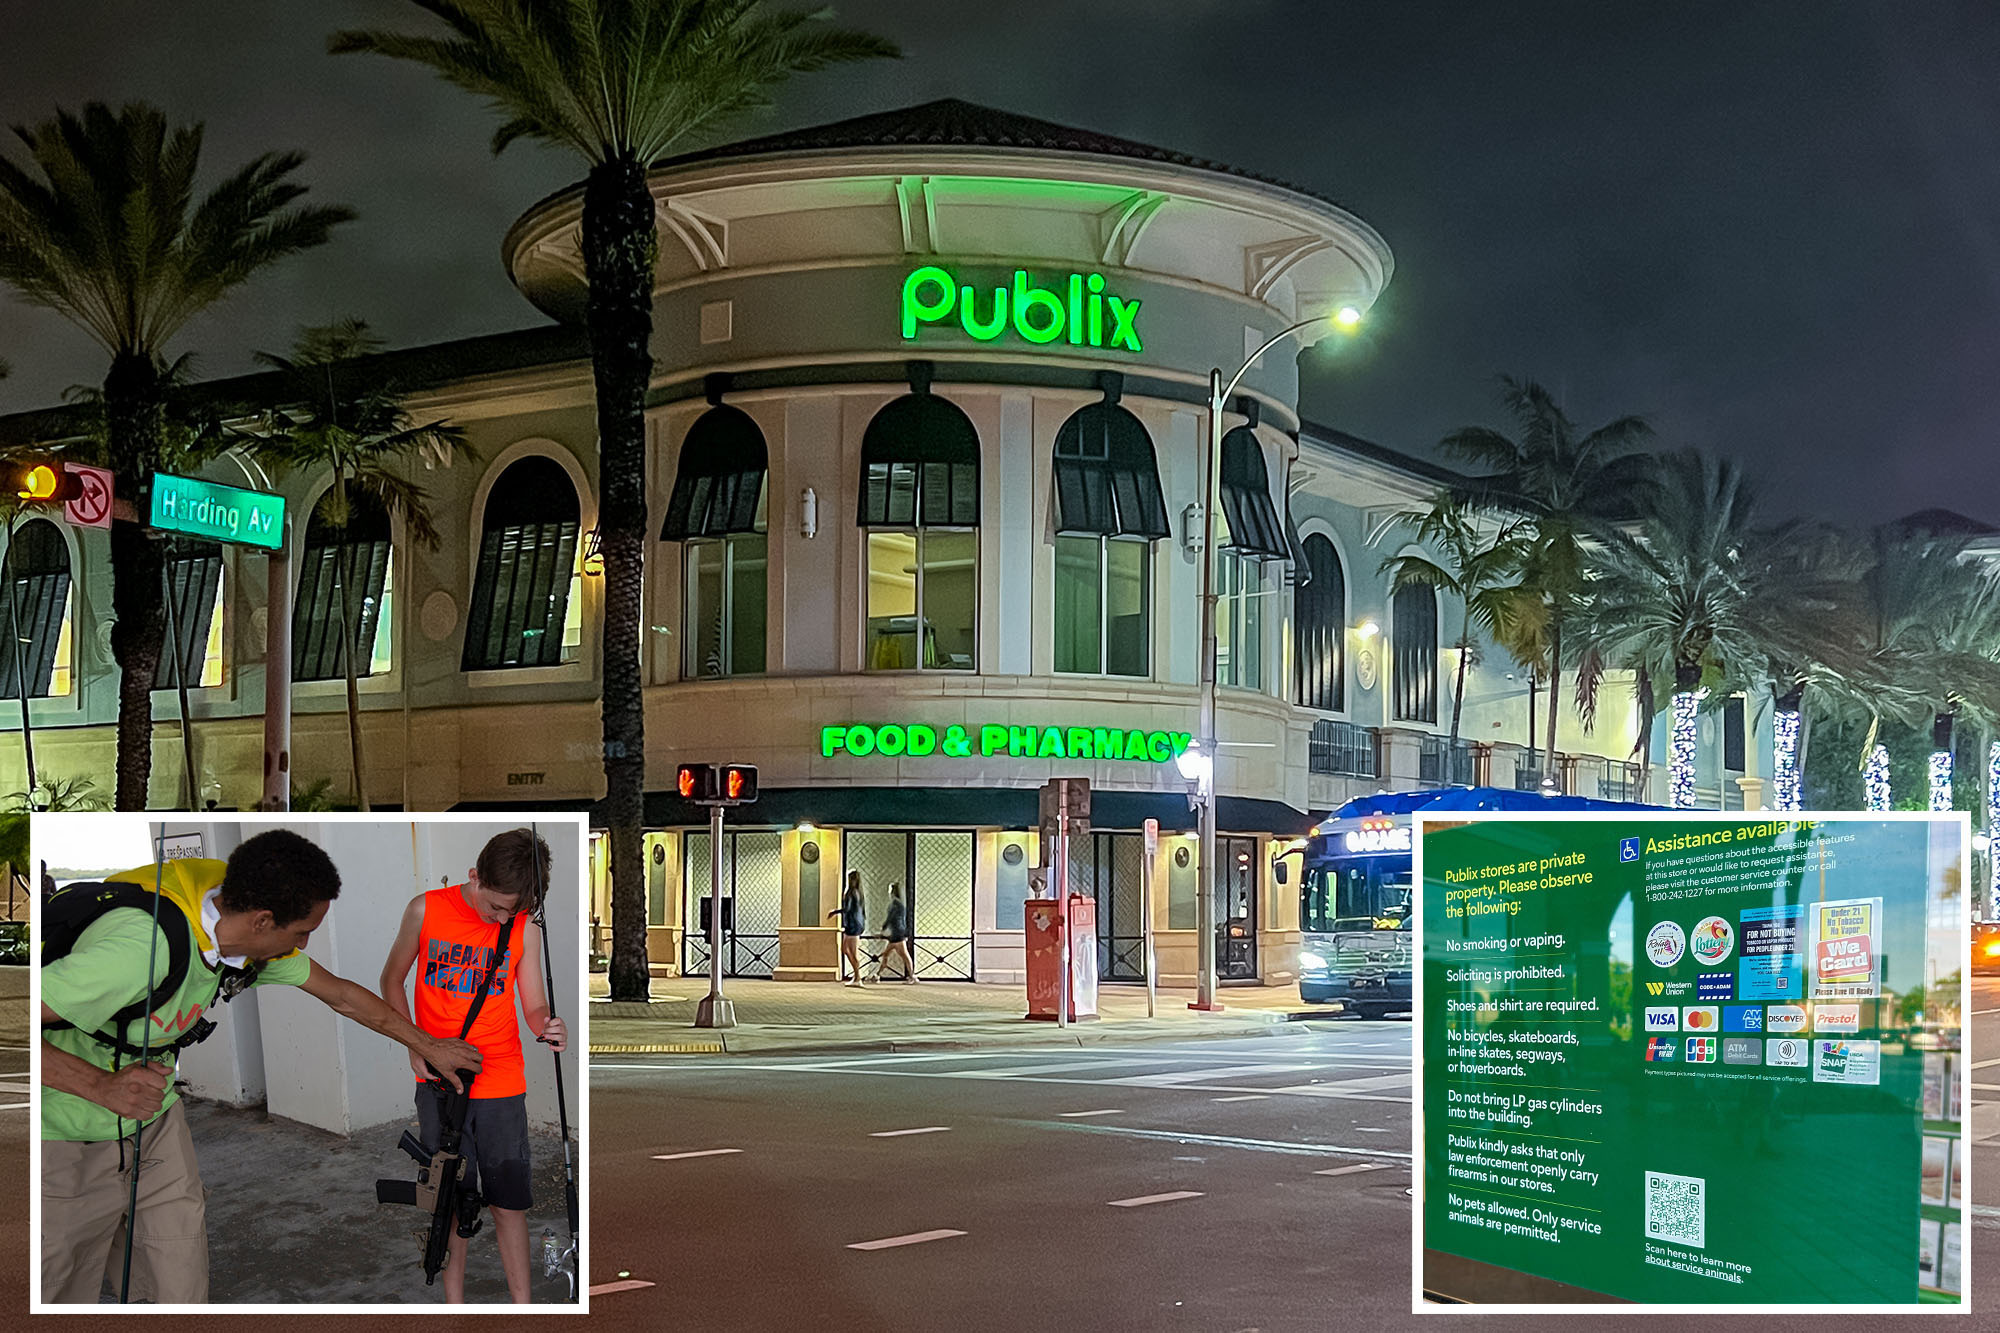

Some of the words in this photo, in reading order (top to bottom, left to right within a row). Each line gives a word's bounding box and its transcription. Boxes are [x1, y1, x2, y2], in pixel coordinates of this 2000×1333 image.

[902, 266, 1143, 352] Publix
[162, 490, 239, 535] Harding
[248, 506, 272, 534] Av
[822, 724, 936, 757] FOOD
[942, 725, 972, 758] &
[980, 724, 1192, 763] PHARMACY
[508, 773, 544, 785] ENTRY
[1645, 831, 1732, 854] Assistance
[1736, 821, 1825, 840] available.
[1646, 861, 1651, 869] If
[1652, 862, 1665, 870] you
[1666, 859, 1684, 867] have
[1685, 853, 1724, 866] questions
[1725, 849, 1750, 858] about
[1752, 847, 1766, 855] the
[1768, 840, 1814, 853] accessible
[1816, 834, 1855, 845] features
[1445, 868, 1478, 883] Publix
[1480, 863, 1516, 878] stores
[1518, 862, 1537, 874] are
[1540, 851, 1585, 873] private
[1669, 869, 1687, 878] store
[1698, 864, 1723, 874] would
[1725, 862, 1738, 871] like
[1751, 856, 1784, 868] request
[1786, 849, 1836, 863] assistance,
[1646, 883, 1669, 894] please
[1671, 880, 1685, 888] visit
[1686, 879, 1699, 887] the
[1701, 874, 1738, 885] customer
[1740, 871, 1769, 880] service
[1772, 866, 1806, 876] counter
[1808, 864, 1817, 872] or
[1820, 860, 1836, 871] call
[1446, 885, 1497, 904] property.
[1499, 879, 1538, 894] Please
[1540, 871, 1593, 889] observe
[1646, 887, 1703, 902] 1-800-242-1227
[1705, 887, 1716, 896] for
[1717, 886, 1739, 894] more
[1741, 879, 1792, 891] information.
[1446, 905, 1464, 918] the
[1466, 900, 1521, 915] following:
[1831, 909, 1850, 917] Under
[1831, 927, 1838, 935] No
[1841, 926, 1860, 935] Vapor
[1838, 917, 1864, 925] Tobacco
[1447, 939, 1460, 952] No
[1463, 936, 1507, 953] smoking
[1510, 937, 1521, 948] or
[1524, 932, 1566, 949] vaping.
[1747, 931, 1758, 939] FOR
[1760, 930, 1771, 938] NOT
[1774, 928, 1795, 937] BUYING
[1696, 937, 1729, 952] Lottery
[1826, 941, 1860, 957] We
[1821, 952, 1868, 971] Card
[1447, 967, 1491, 984] Soliciting
[1494, 967, 1502, 980] is
[1504, 964, 1565, 984] prohibited.
[1447, 999, 1476, 1012] Shoes
[1478, 999, 1497, 1011] and
[1500, 999, 1523, 1011] shirt
[1525, 1001, 1543, 1011] are
[1546, 997, 1599, 1014] required.
[1647, 1014, 1675, 1025] VISA
[1768, 1015, 1804, 1023] DISCOVER
[1817, 1014, 1856, 1023] Presto!
[1448, 1029, 1461, 1042] No
[1464, 1029, 1506, 1046] bicycles,
[1509, 1031, 1580, 1046] skateboards,
[1649, 1043, 1676, 1052] UnionPay
[1448, 1045, 1476, 1058] in-line
[1479, 1047, 1514, 1062] skates,
[1516, 1049, 1566, 1064] segways,
[1688, 1046, 1713, 1054] JCB
[1728, 1044, 1747, 1052] ATM
[1448, 1063, 1458, 1072] or
[1460, 1062, 1526, 1077] hoverboards.
[1821, 1058, 1846, 1067] SNAP
[1448, 1090, 1462, 1102] Do
[1465, 1092, 1480, 1104] not
[1483, 1092, 1510, 1109] bring
[1512, 1095, 1525, 1107] LP
[1528, 1099, 1547, 1112] gas
[1550, 1097, 1602, 1115] cylinders
[1448, 1106, 1467, 1119] into
[1469, 1107, 1485, 1120] the
[1487, 1109, 1533, 1128] building.
[1448, 1134, 1477, 1149] Publix
[1479, 1137, 1509, 1158] kindly
[1511, 1142, 1533, 1156] asks
[1536, 1145, 1558, 1160] that
[1560, 1148, 1585, 1166] only
[1448, 1150, 1464, 1162] law
[1466, 1152, 1528, 1172] enforcement
[1531, 1162, 1567, 1180] openly
[1570, 1169, 1599, 1185] carry
[1448, 1165, 1487, 1182] firearms
[1490, 1171, 1498, 1183] in
[1501, 1176, 1517, 1188] our
[1520, 1179, 1555, 1193] stores.
[1448, 1193, 1463, 1206] No
[1465, 1198, 1486, 1212] pets
[1488, 1201, 1529, 1220] allowed.
[1532, 1209, 1558, 1227] Only
[1560, 1216, 1601, 1235] service
[1448, 1209, 1484, 1226] animals
[1487, 1220, 1502, 1230] are
[1504, 1222, 1561, 1243] permitted.
[1646, 1243, 1665, 1255] Scan
[1667, 1247, 1687, 1259] here
[1689, 1253, 1698, 1262] to
[1701, 1254, 1723, 1267] learn
[1726, 1261, 1751, 1273] more
[1645, 1254, 1670, 1266] about
[1672, 1261, 1703, 1274] service
[1705, 1268, 1744, 1283] animals.
